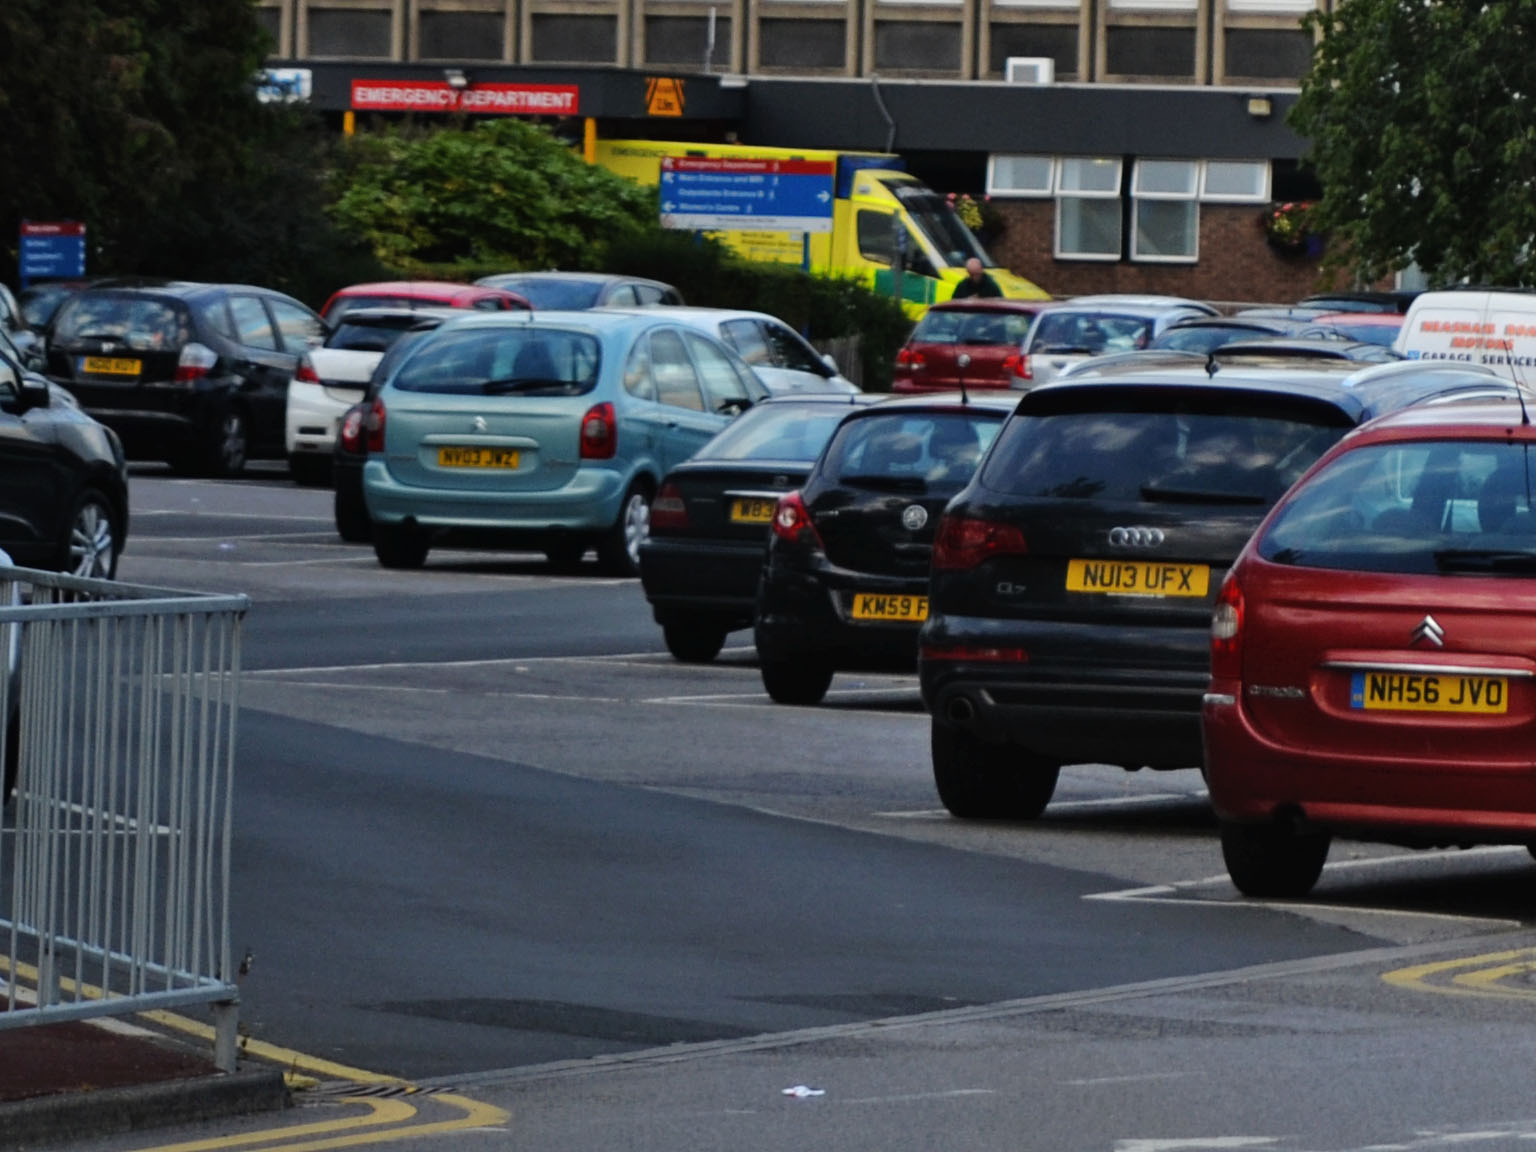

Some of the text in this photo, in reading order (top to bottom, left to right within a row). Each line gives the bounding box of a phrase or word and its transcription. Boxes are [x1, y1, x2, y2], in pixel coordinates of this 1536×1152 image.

[354, 86, 576, 108] EMERGENCY DEPARTMENT
[1450, 336, 1514, 350] MOTORS
[443, 449, 513, 466] NV03 JWZ
[1083, 563, 1194, 590] NU13 UFX
[861, 596, 910, 616] KM59
[1369, 673, 1503, 705] NH56 JVO
